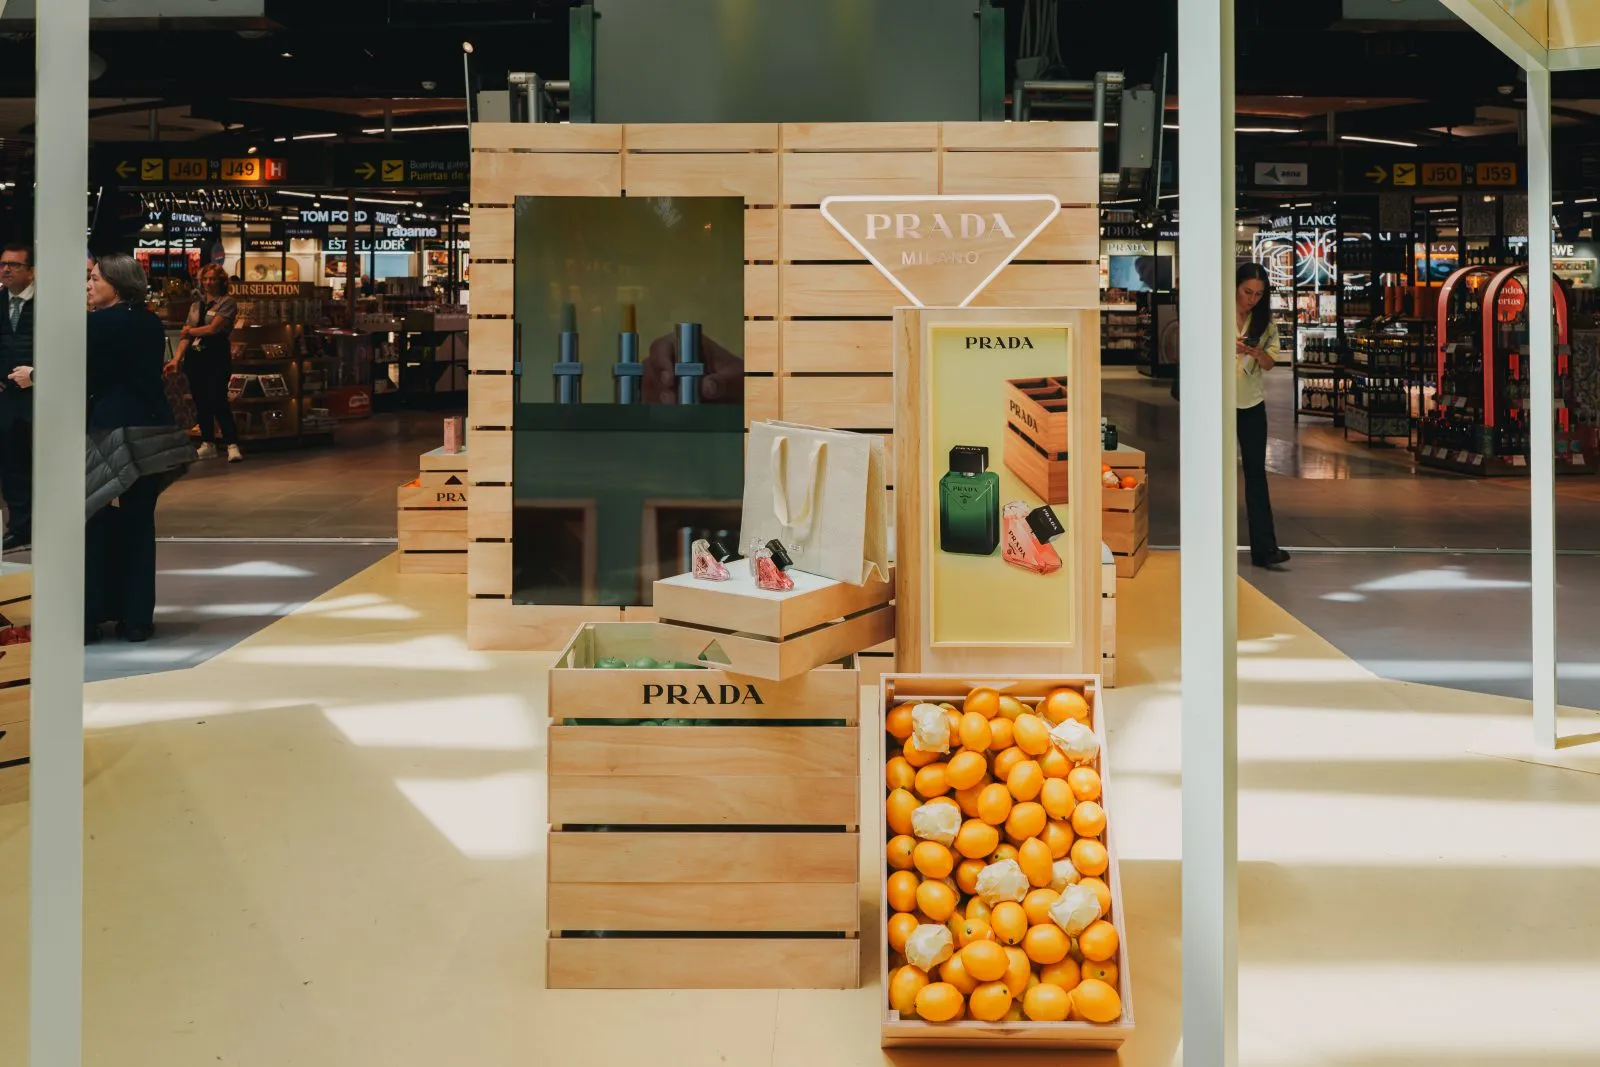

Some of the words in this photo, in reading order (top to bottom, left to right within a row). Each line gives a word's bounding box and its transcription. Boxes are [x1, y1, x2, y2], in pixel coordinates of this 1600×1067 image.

[174, 162, 203, 177] J40
[210, 160, 219, 168] to
[226, 162, 255, 177] J49
[271, 162, 282, 176] H
[410, 160, 445, 170] Boarding
[211, 172, 217, 180] a
[411, 171, 448, 180] Puertas
[451, 171, 464, 180] de
[1427, 168, 1457, 182] J50
[1482, 168, 1511, 182] J59
[171, 212, 202, 223] GIVENCHY
[301, 210, 329, 222] TOM
[386, 226, 437, 238] rabanne
[864, 212, 1016, 240] PRADA
[901, 250, 980, 266] MILANO
[250, 284, 300, 295] SELECTION
[964, 335, 1035, 350] PRADA
[1009, 399, 1039, 435] PRADA
[952, 485, 979, 493] PRADA
[436, 492, 467, 502] PRA
[1042, 508, 1059, 531] PRADA
[1008, 530, 1027, 559] PRADA
[641, 684, 765, 705] PRADA
